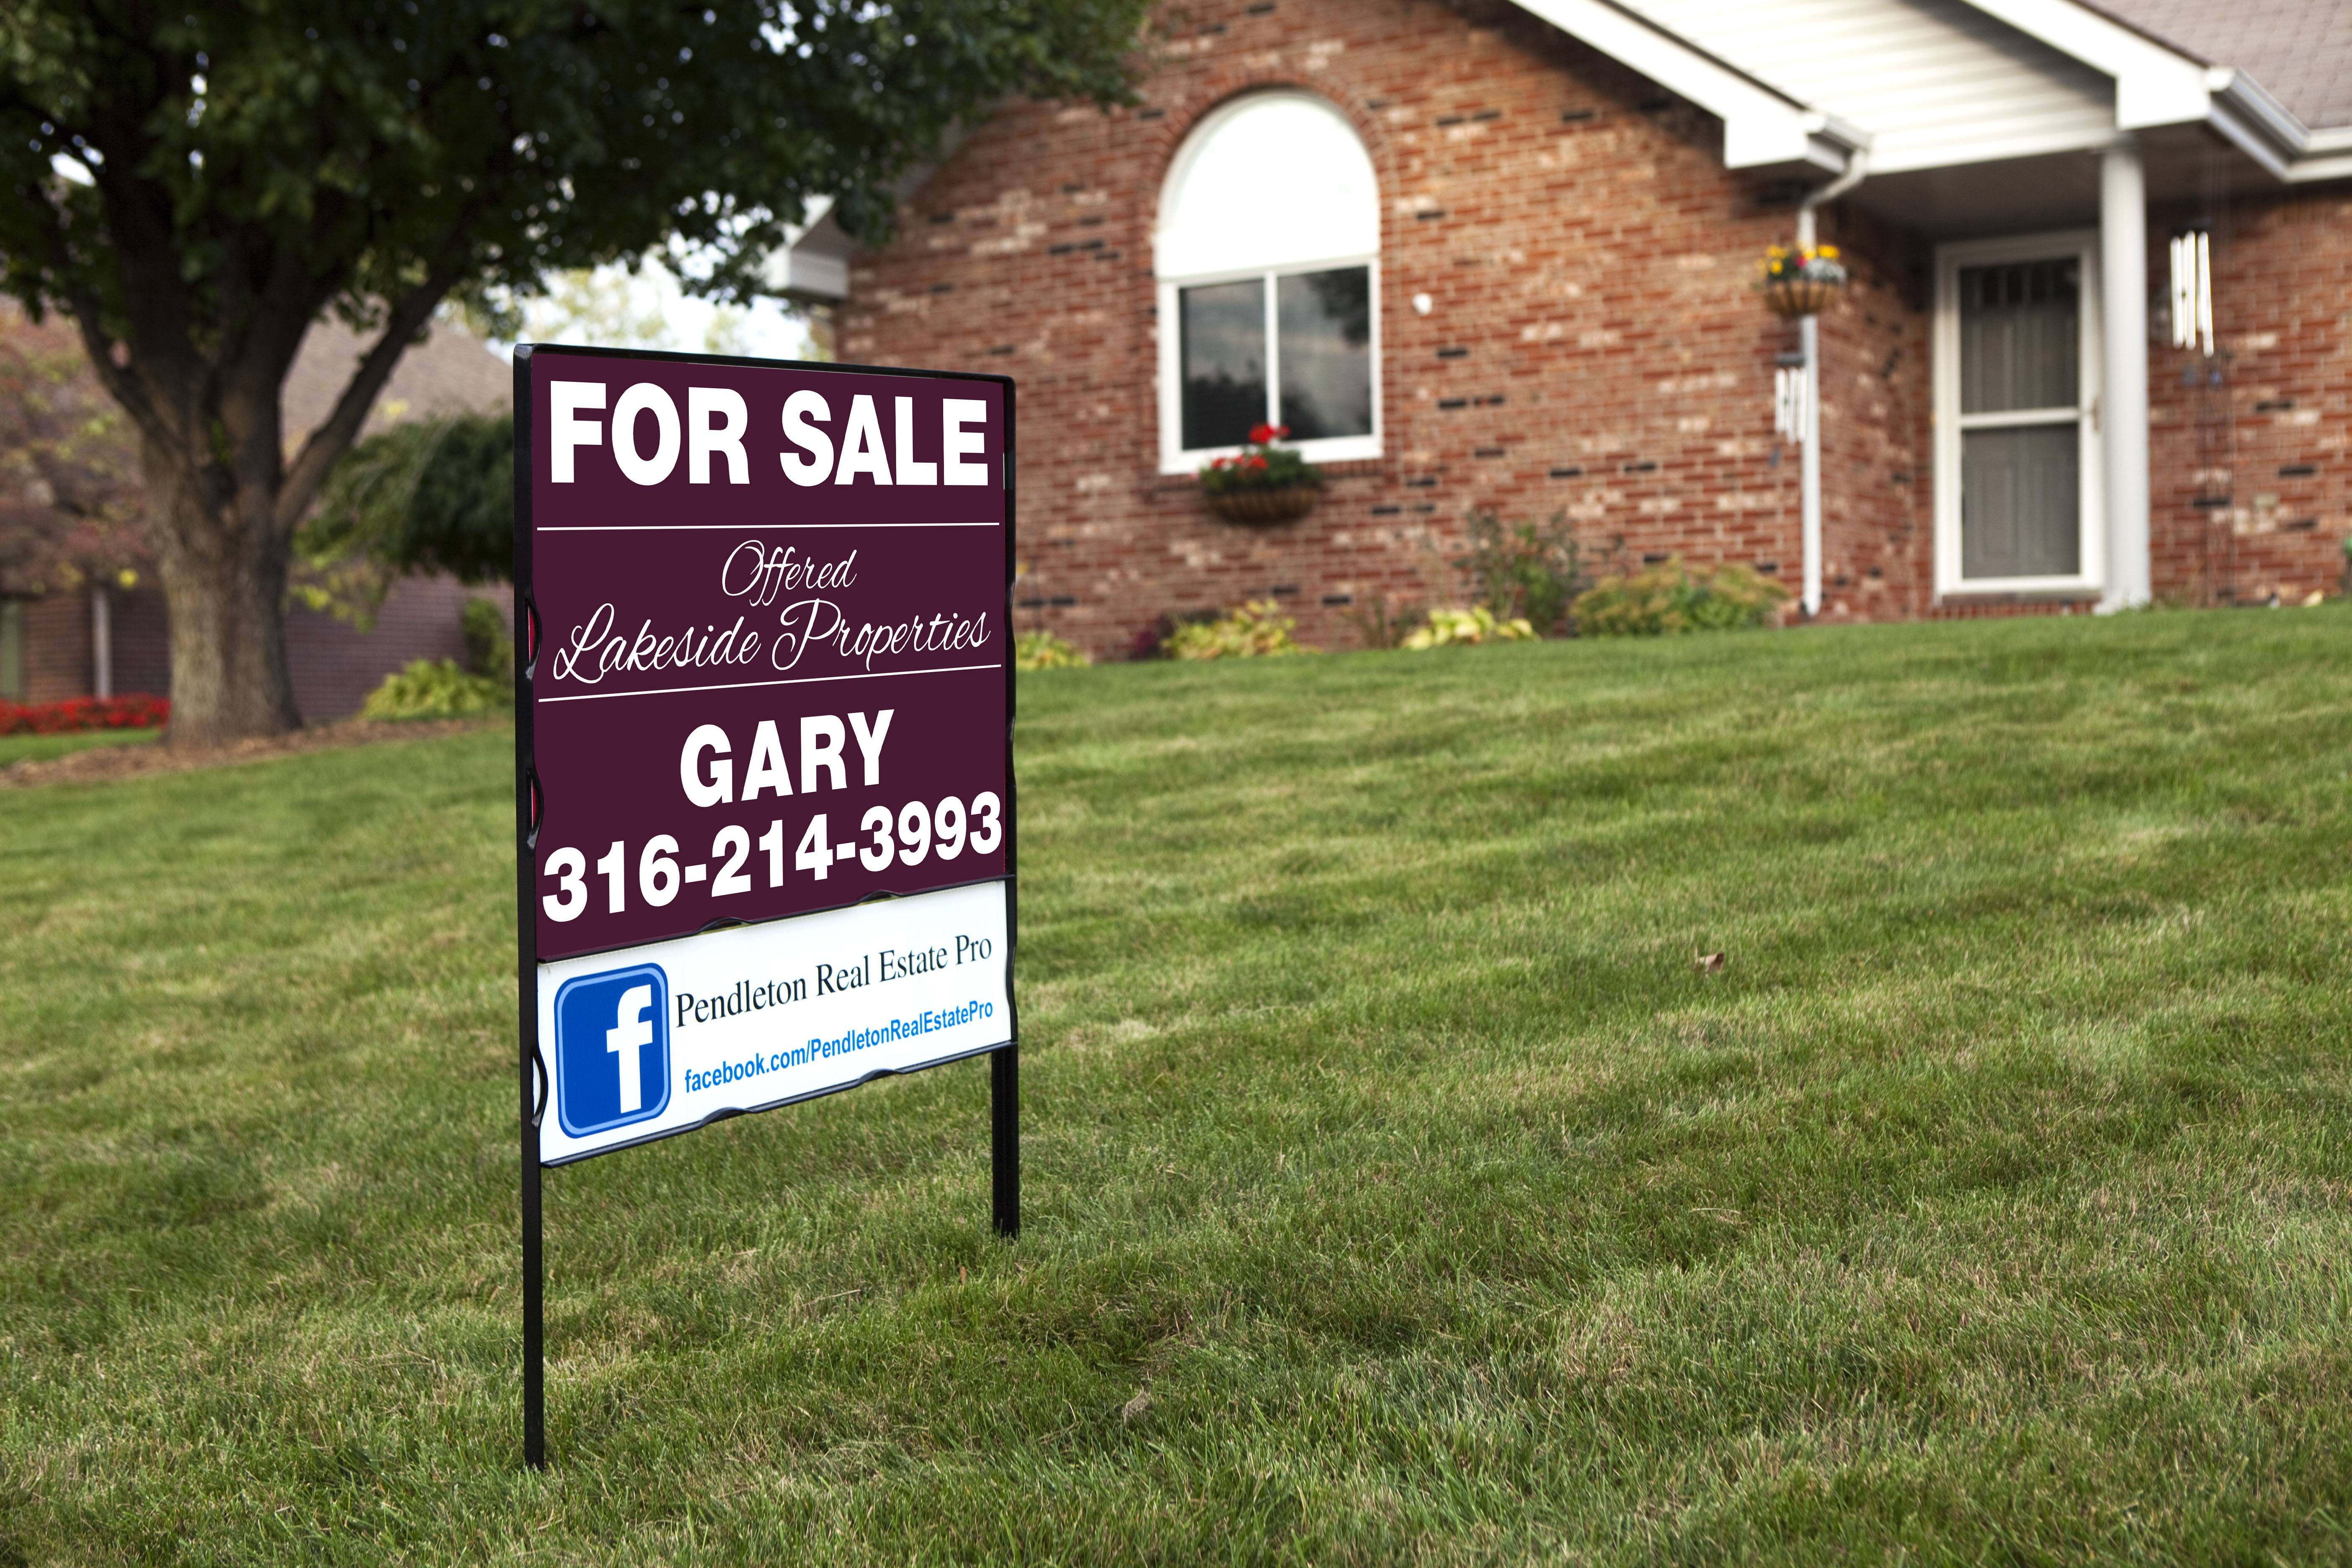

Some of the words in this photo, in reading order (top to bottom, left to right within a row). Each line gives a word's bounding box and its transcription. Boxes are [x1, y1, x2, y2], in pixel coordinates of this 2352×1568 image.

[550, 380, 750, 486] FOR
[780, 390, 988, 487] SALE
[722, 539, 858, 607] Offered
[553, 603, 762, 684] Lakeside
[771, 598, 991, 672] Properties
[680, 709, 895, 807] GARY
[542, 791, 1002, 922] 316-214-3993
[675, 978, 807, 1028] Pendleton
[815, 954, 870, 996] Real
[879, 946, 947, 982] Estate
[955, 935, 992, 965] Pro
[606, 985, 652, 1114] f
[685, 1001, 993, 1093] facebook.com/PendletonRealEstatePro
